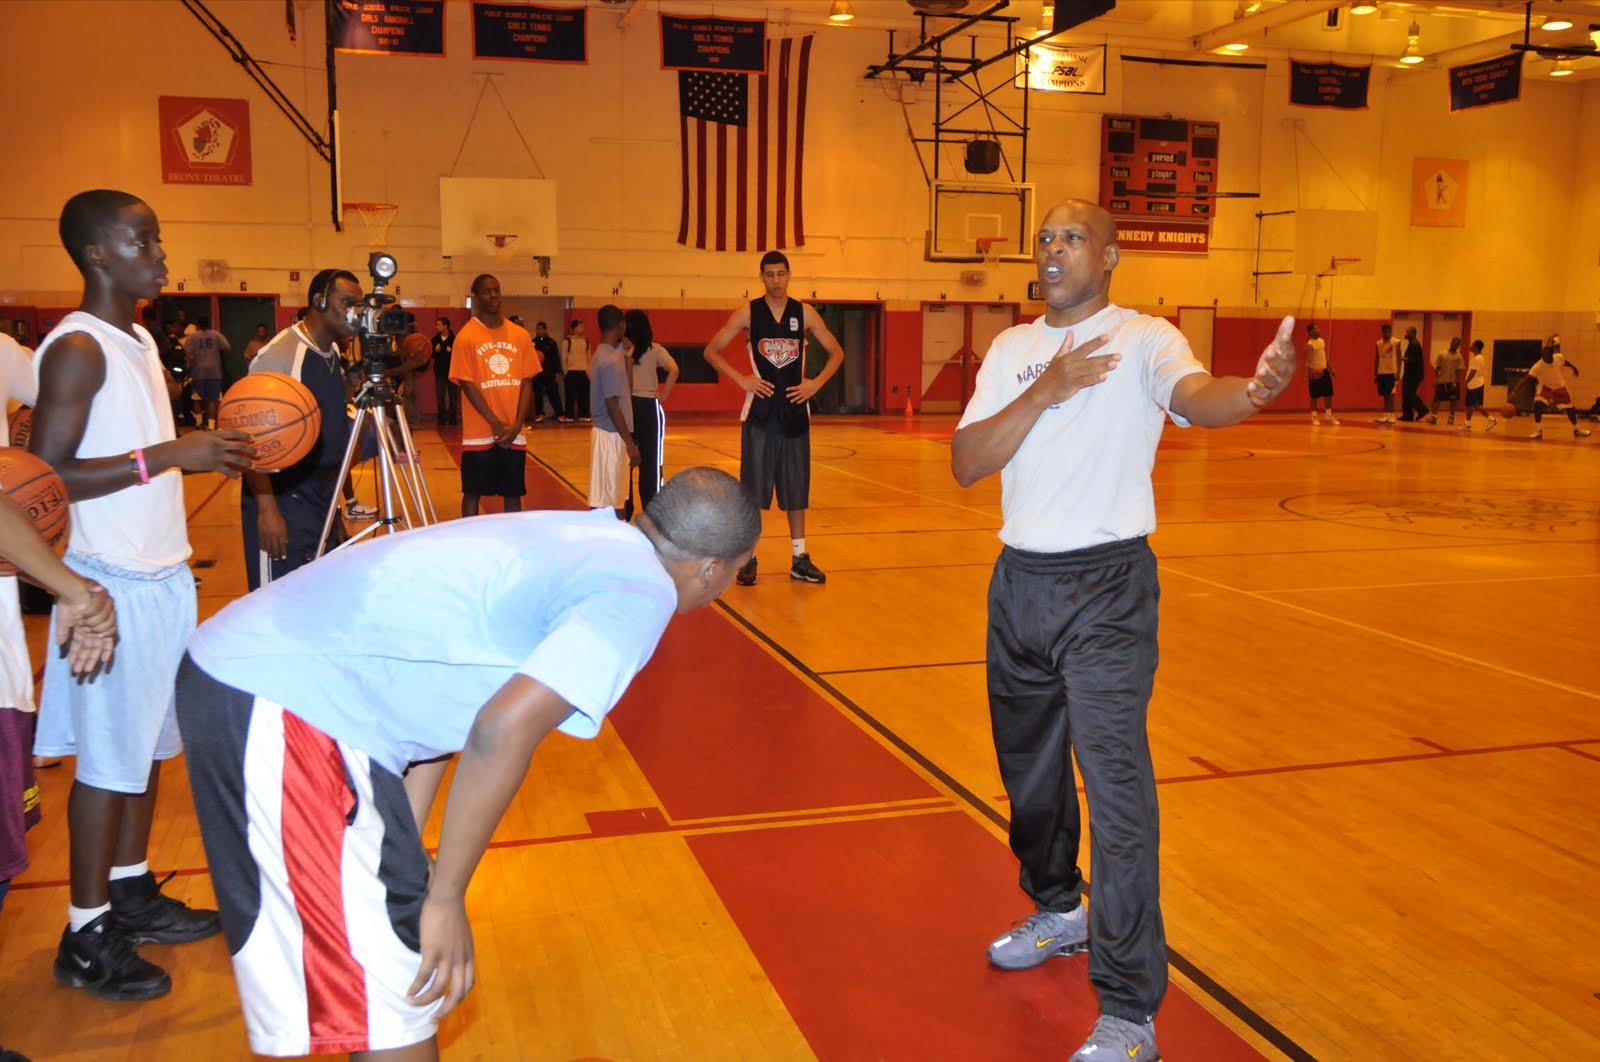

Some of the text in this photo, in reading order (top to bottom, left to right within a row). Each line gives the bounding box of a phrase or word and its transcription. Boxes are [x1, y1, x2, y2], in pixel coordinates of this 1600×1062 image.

[371, 25, 405, 35] CHAMPIONS
[512, 33, 547, 43] CHAMPIONS
[697, 45, 730, 54] CHAMPIONS
[1151, 153, 1174, 162] period
[168, 172, 246, 184] BRONX THEATRE
[1116, 230, 1206, 244] NNEDY KNIGHTS
[476, 341, 518, 357] FIVE-STAR
